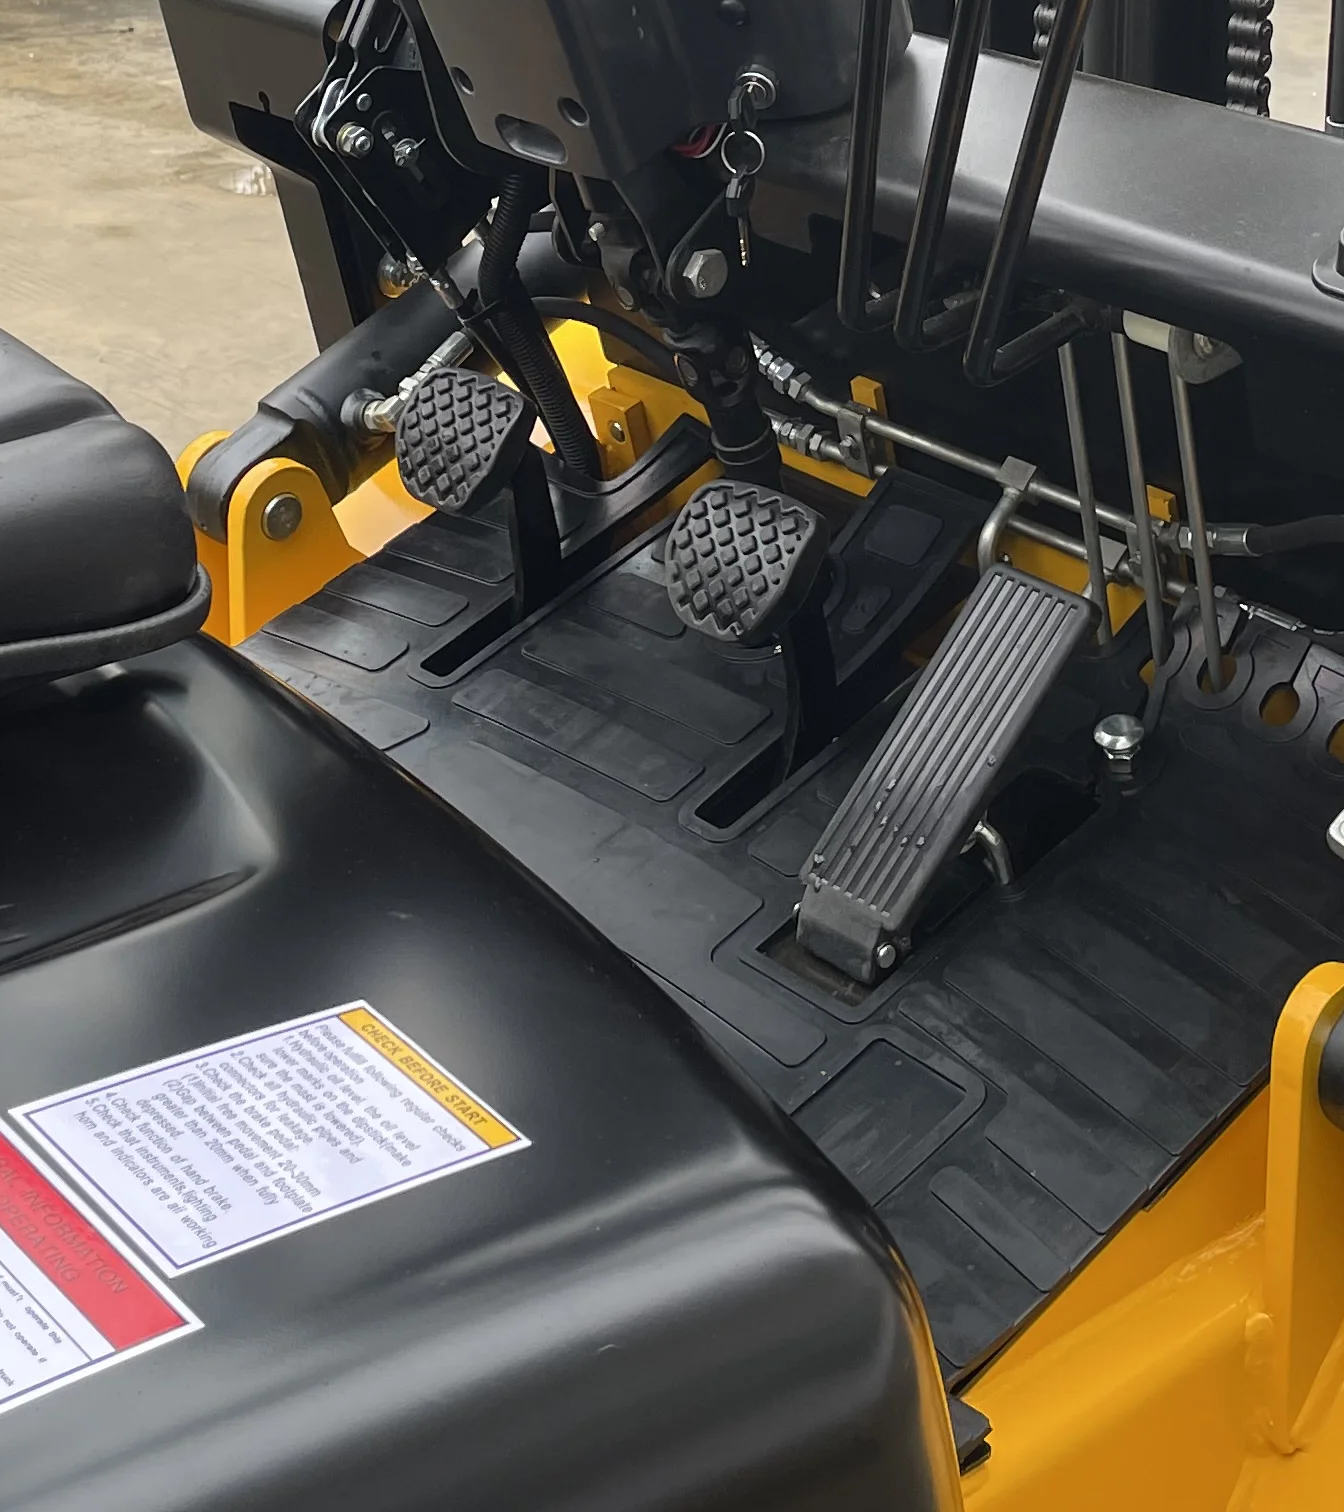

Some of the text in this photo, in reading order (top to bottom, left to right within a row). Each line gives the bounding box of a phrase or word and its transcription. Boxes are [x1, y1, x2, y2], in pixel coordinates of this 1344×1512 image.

[254, 1052, 278, 1069] sure
[274, 1068, 293, 1083] the
[290, 1082, 317, 1103] mast
[311, 1101, 326, 1112] is
[271, 1046, 299, 1067] lower
[295, 1066, 325, 1090] marks
[321, 1090, 338, 1102] on
[335, 1100, 354, 1116] the
[297, 1028, 364, 1084] before operation
[360, 1022, 488, 1125] CHECK BEFORE START
[84, 1096, 123, 1129] 5.Check
[117, 1127, 141, 1146] that
[104, 1091, 141, 1123] 4.Check
[135, 1121, 173, 1154] function
[169, 1154, 188, 1164] of
[179, 1163, 210, 1186] hand
[150, 1092, 279, 1205] greater than 20mm when fully
[162, 1078, 313, 1213] (2)Gap between pedal and footplate
[215, 1102, 238, 1120] free
[234, 1119, 282, 1160] movement
[227, 1090, 247, 1105] the
[242, 1104, 271, 1128] brake
[262, 1080, 283, 1091] all
[275, 1090, 317, 1125] hydraulic
[310, 1124, 342, 1147] pipes
[338, 1147, 364, 1164] and
[325, 1073, 345, 1085] oil
[363, 1104, 382, 1120] the
[379, 1119, 398, 1132] oil
[392, 1130, 421, 1151] level
[362, 1064, 403, 1098] following
[399, 1097, 435, 1123] regular
[431, 1124, 466, 1152] checks
[92, 1130, 118, 1147] and
[110, 1146, 154, 1186] indicators
[149, 1185, 170, 1201] are
[166, 1201, 188, 1214] all
[180, 1214, 217, 1249] working
[22, 1188, 129, 1295] INFORMATION
